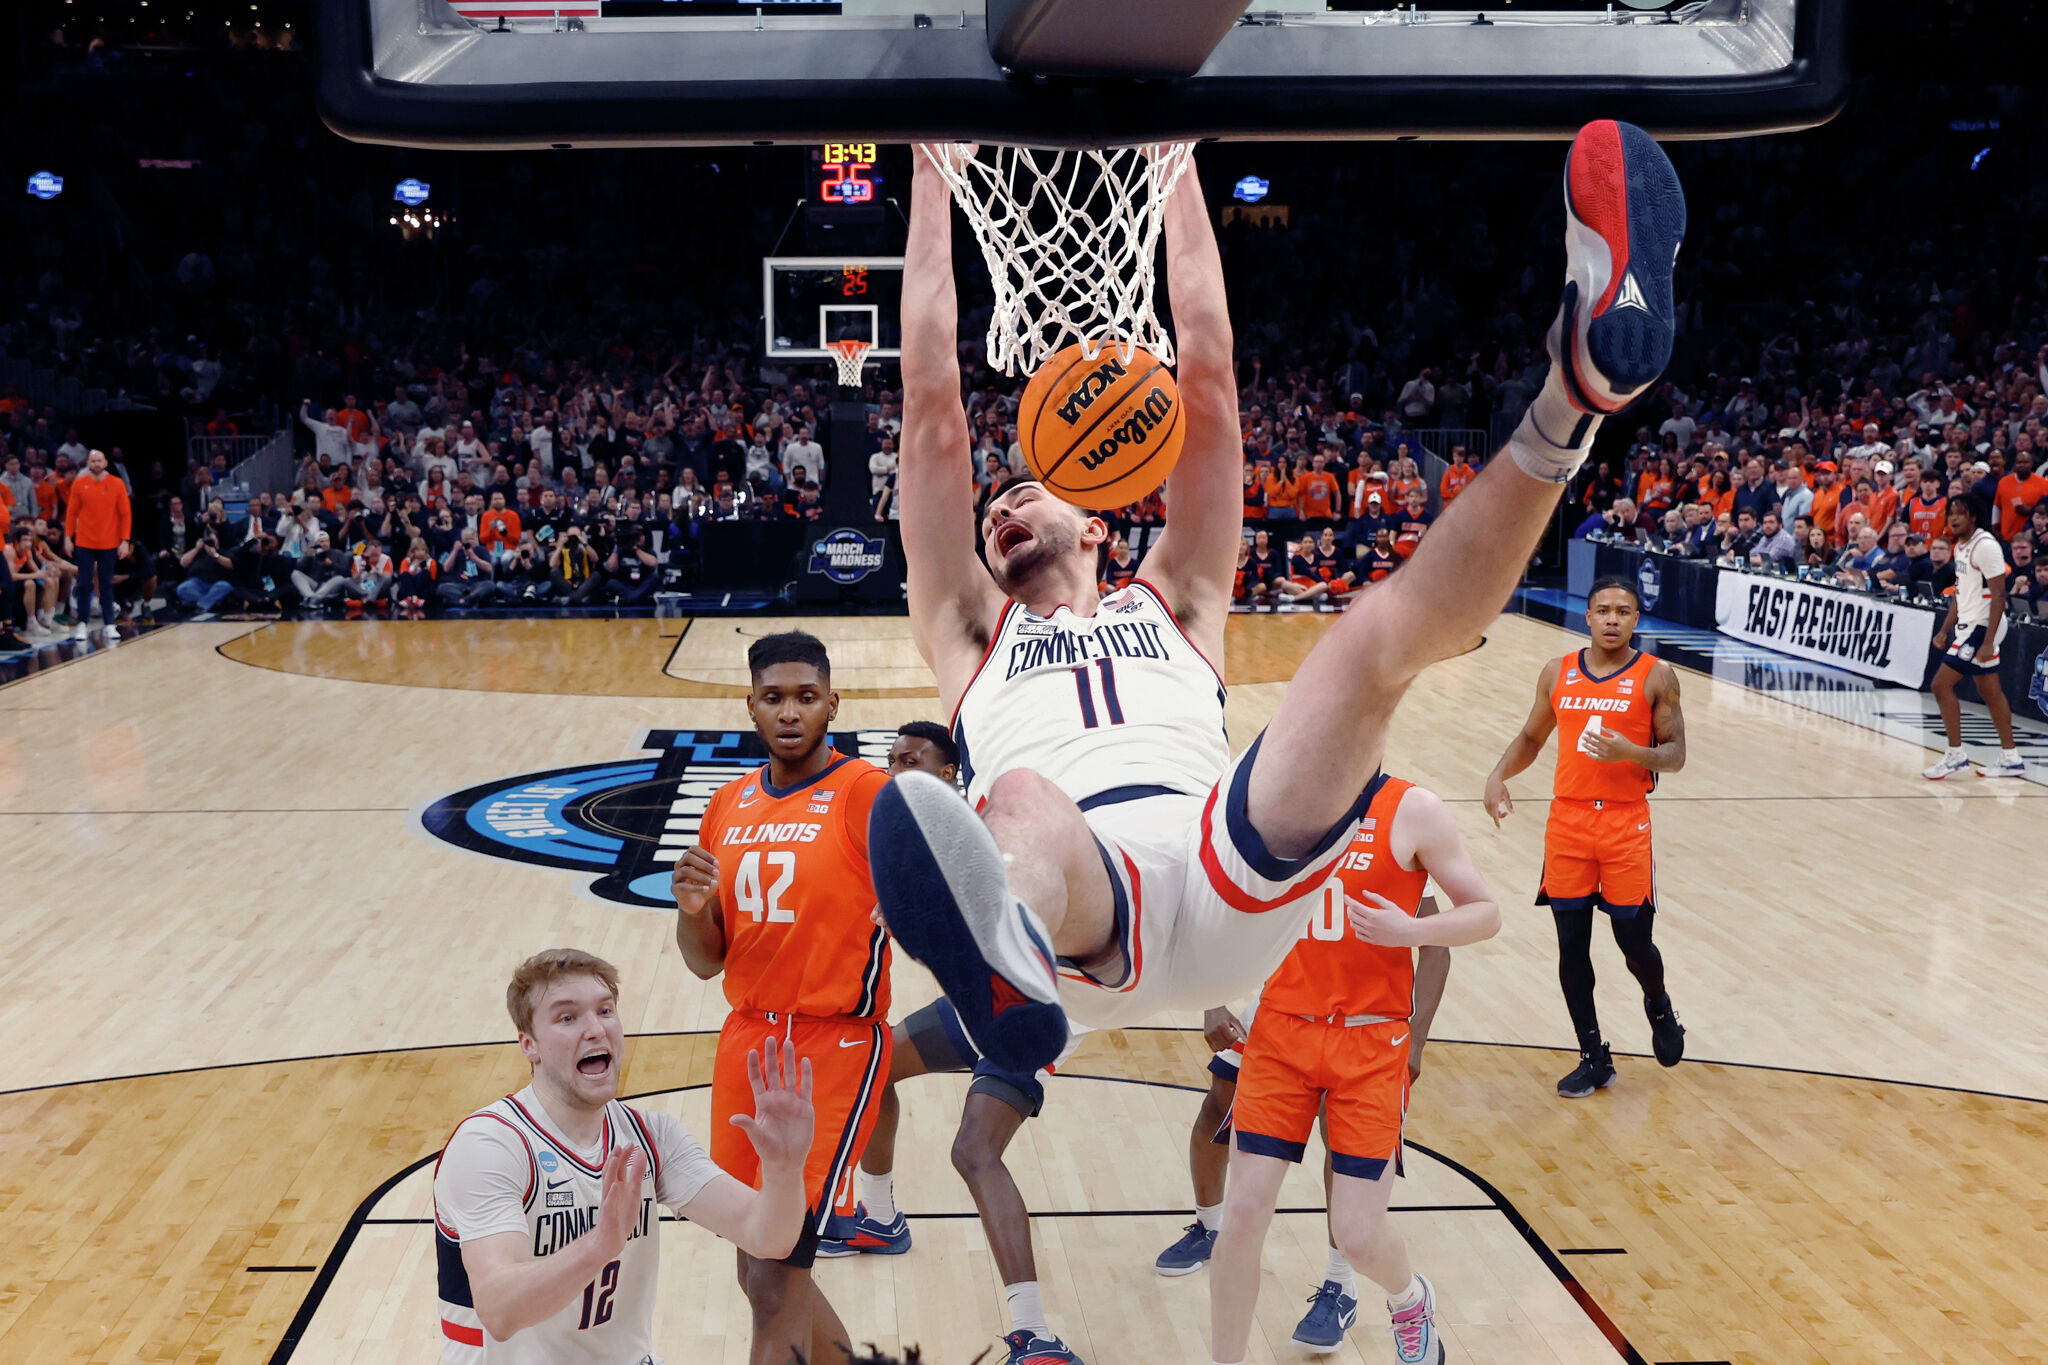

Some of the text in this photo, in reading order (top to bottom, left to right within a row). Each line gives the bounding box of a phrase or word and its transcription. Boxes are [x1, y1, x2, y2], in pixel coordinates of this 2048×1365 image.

[824, 143, 877, 163] 13:43
[821, 163, 873, 202] 25
[1056, 358, 1128, 426] NCAA
[1078, 387, 1173, 471] Wilson
[826, 542, 865, 555] MARCH
[830, 554, 882, 567] MADNESS
[1790, 593, 1894, 668] REGIONAL
[1071, 657, 1125, 729] 11
[1559, 696, 1631, 712] ILLINOIS
[486, 801, 568, 838] SWEET
[722, 823, 822, 846] ILLINOIS
[734, 850, 797, 924] 42
[578, 1260, 621, 1330] 12
